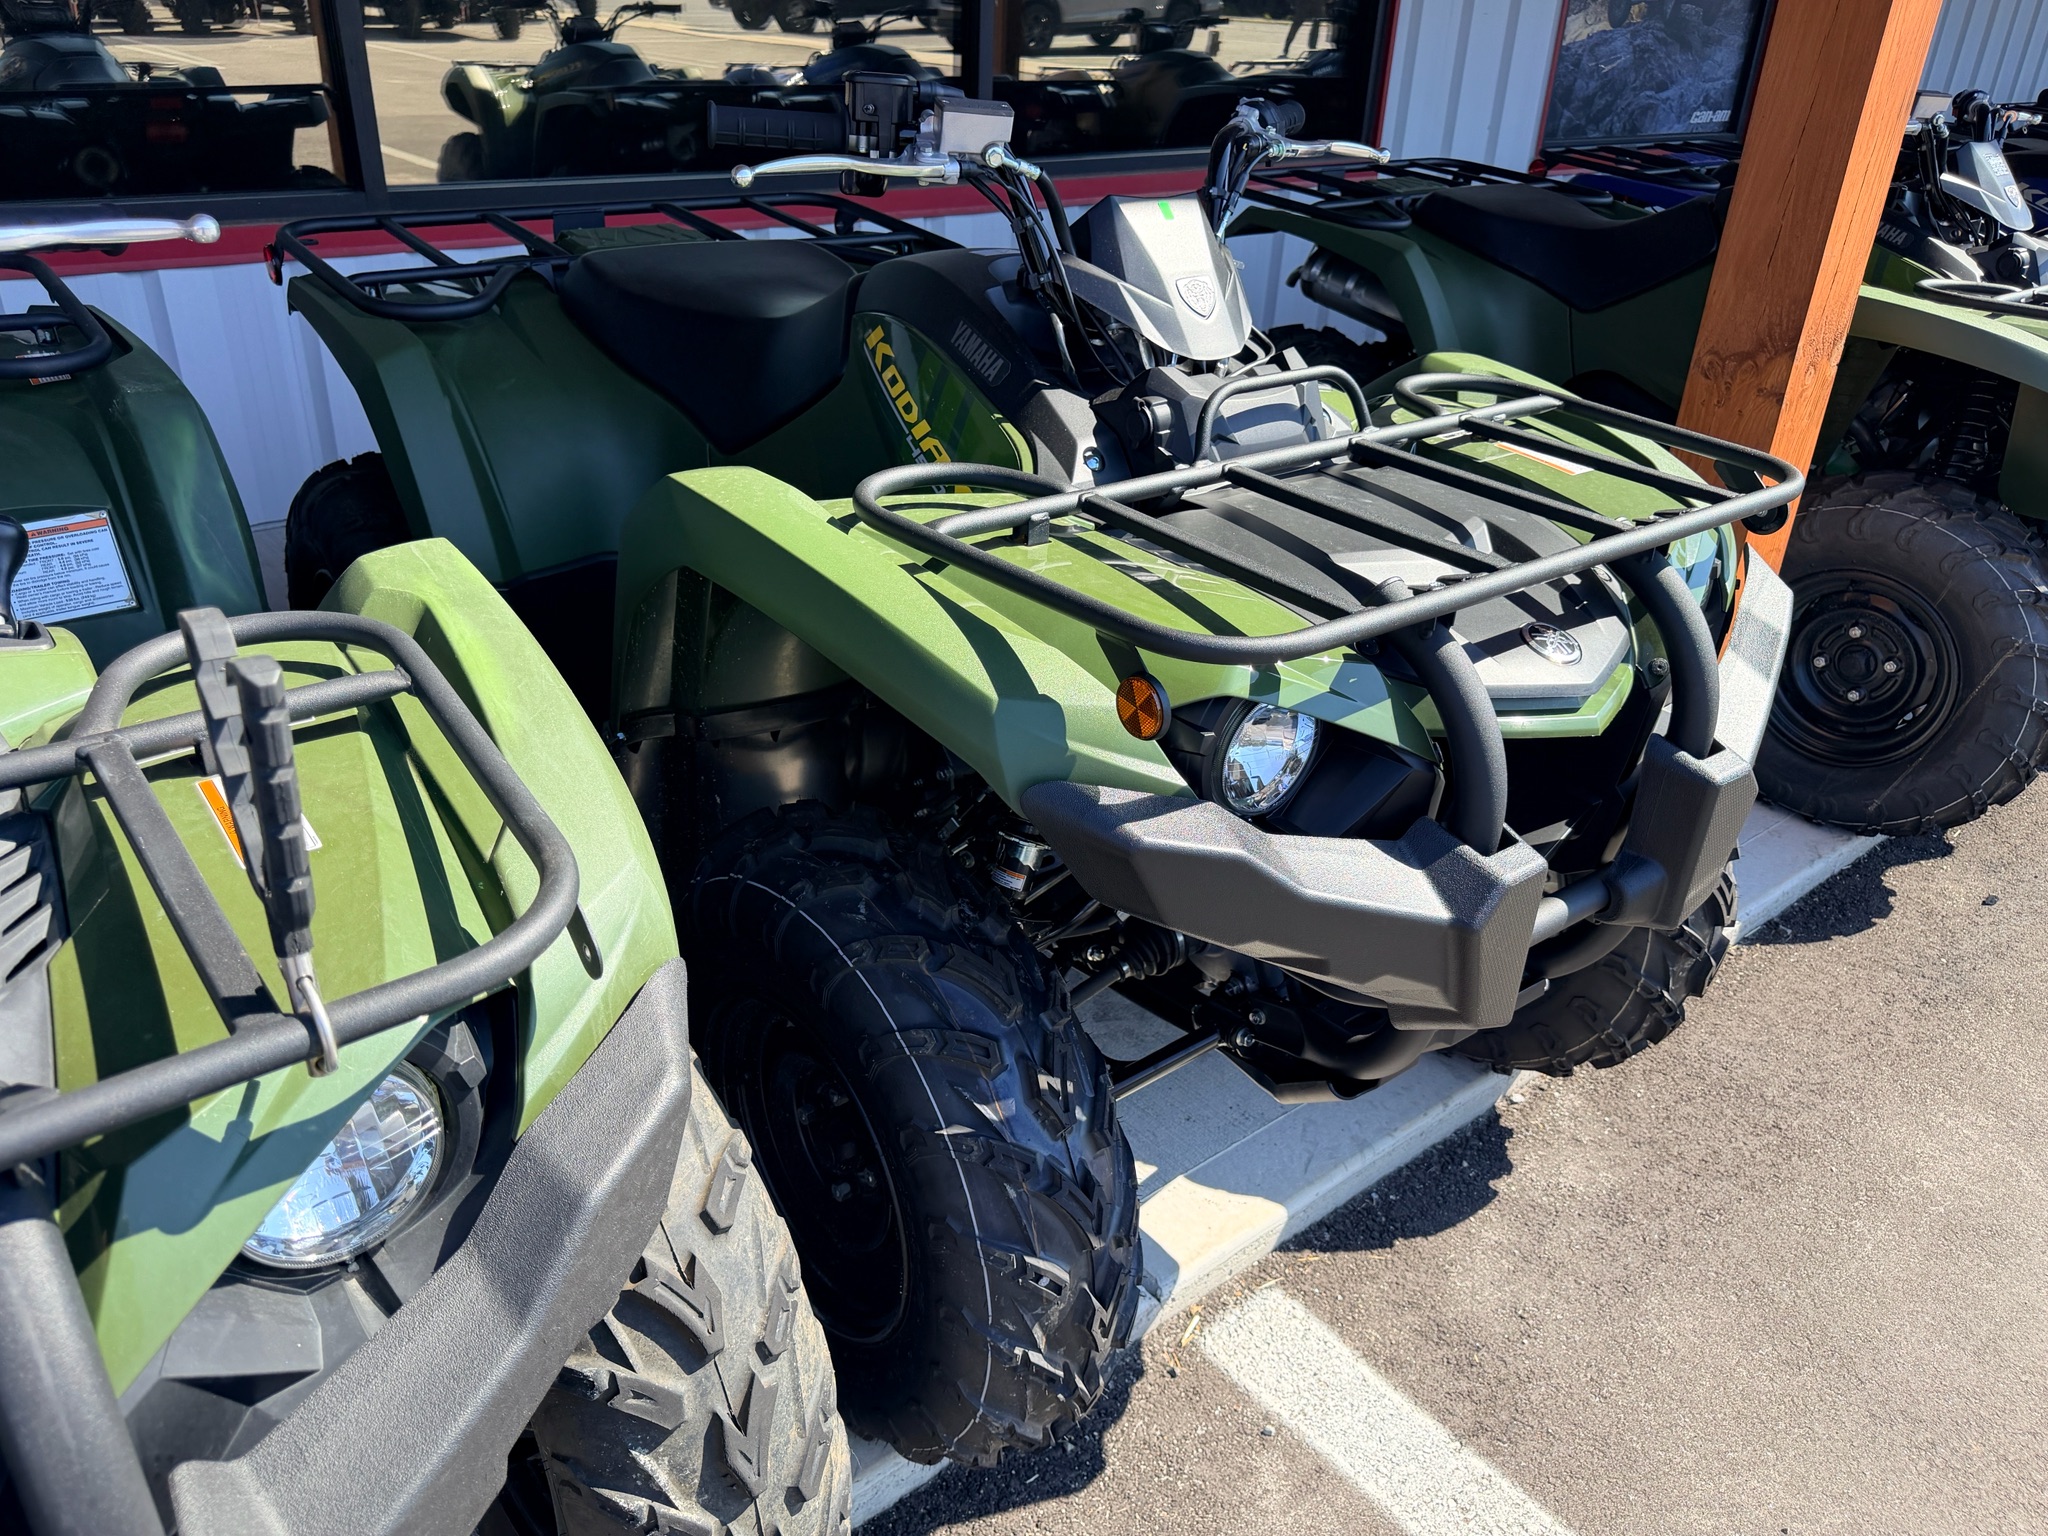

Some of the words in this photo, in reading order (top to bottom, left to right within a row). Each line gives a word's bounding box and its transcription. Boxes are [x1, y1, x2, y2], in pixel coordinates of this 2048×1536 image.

[1690, 110, 1731, 124] can-am
[951, 320, 1004, 382] YAMAHA
[865, 325, 973, 494] KODIA
[36, 526, 69, 535] WARNING
